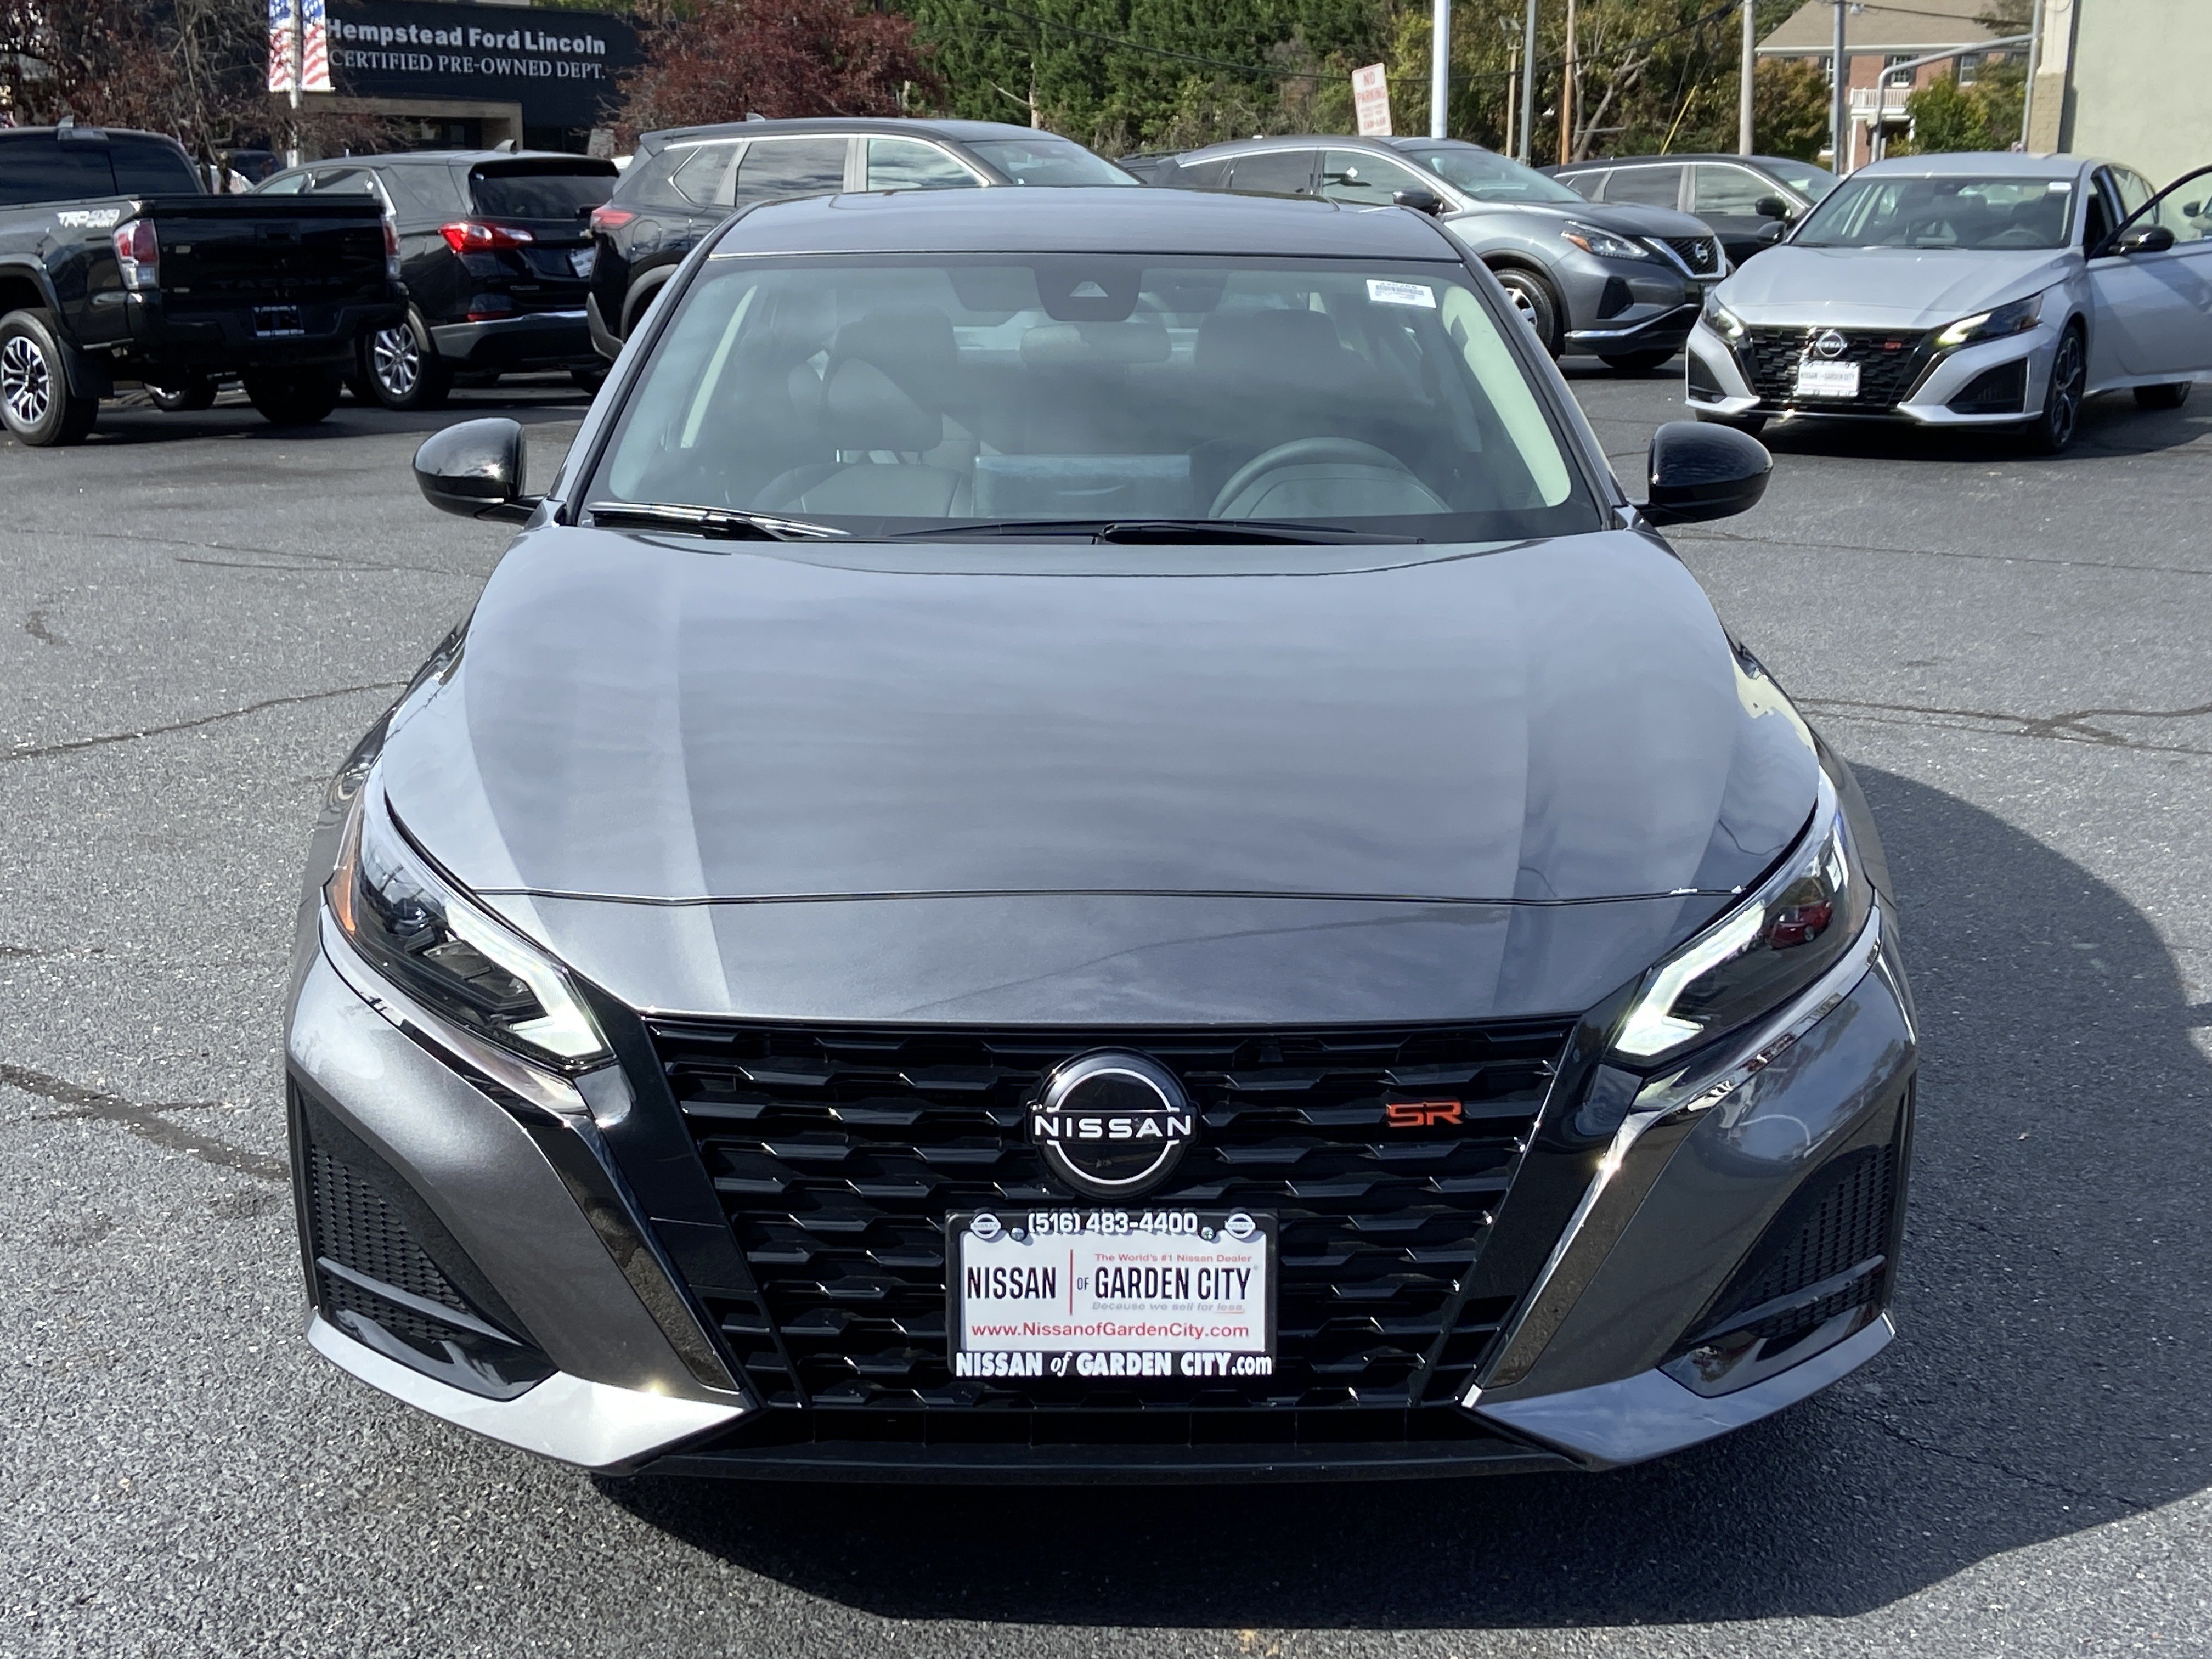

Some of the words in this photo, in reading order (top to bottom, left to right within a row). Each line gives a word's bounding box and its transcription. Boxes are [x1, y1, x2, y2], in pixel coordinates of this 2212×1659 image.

[326, 18, 462, 46] Hempstead
[469, 28, 520, 49] Ford
[524, 31, 606, 54] Lincoln
[329, 49, 433, 71] CERTIFIED
[438, 55, 552, 77] PRE-OWNED
[556, 60, 606, 79] DEPT.
[1363, 71, 1376, 87] NO
[1357, 86, 1386, 103] PARKING
[1386, 1101, 1463, 1128] SR
[1035, 1115, 1190, 1138] NISSAN
[1028, 1212, 1080, 1233] (516)
[1086, 1212, 1198, 1233] 483-4400
[1118, 1253, 1158, 1262] World's
[1216, 1254, 1252, 1262] Dealer
[967, 1266, 1056, 1299] NISSAN
[1077, 1277, 1089, 1291] OF
[1095, 1266, 1189, 1299] GARDEN
[1198, 1267, 1251, 1300] CITY
[1092, 1302, 1146, 1311] Because
[1172, 1302, 1193, 1311] sell
[1197, 1302, 1214, 1311] for
[971, 1322, 1249, 1339] www.NissanofGardenCity.com
[956, 1351, 1043, 1377] NISSAN
[1050, 1351, 1073, 1377] of
[1076, 1351, 1172, 1376] GARDEN
